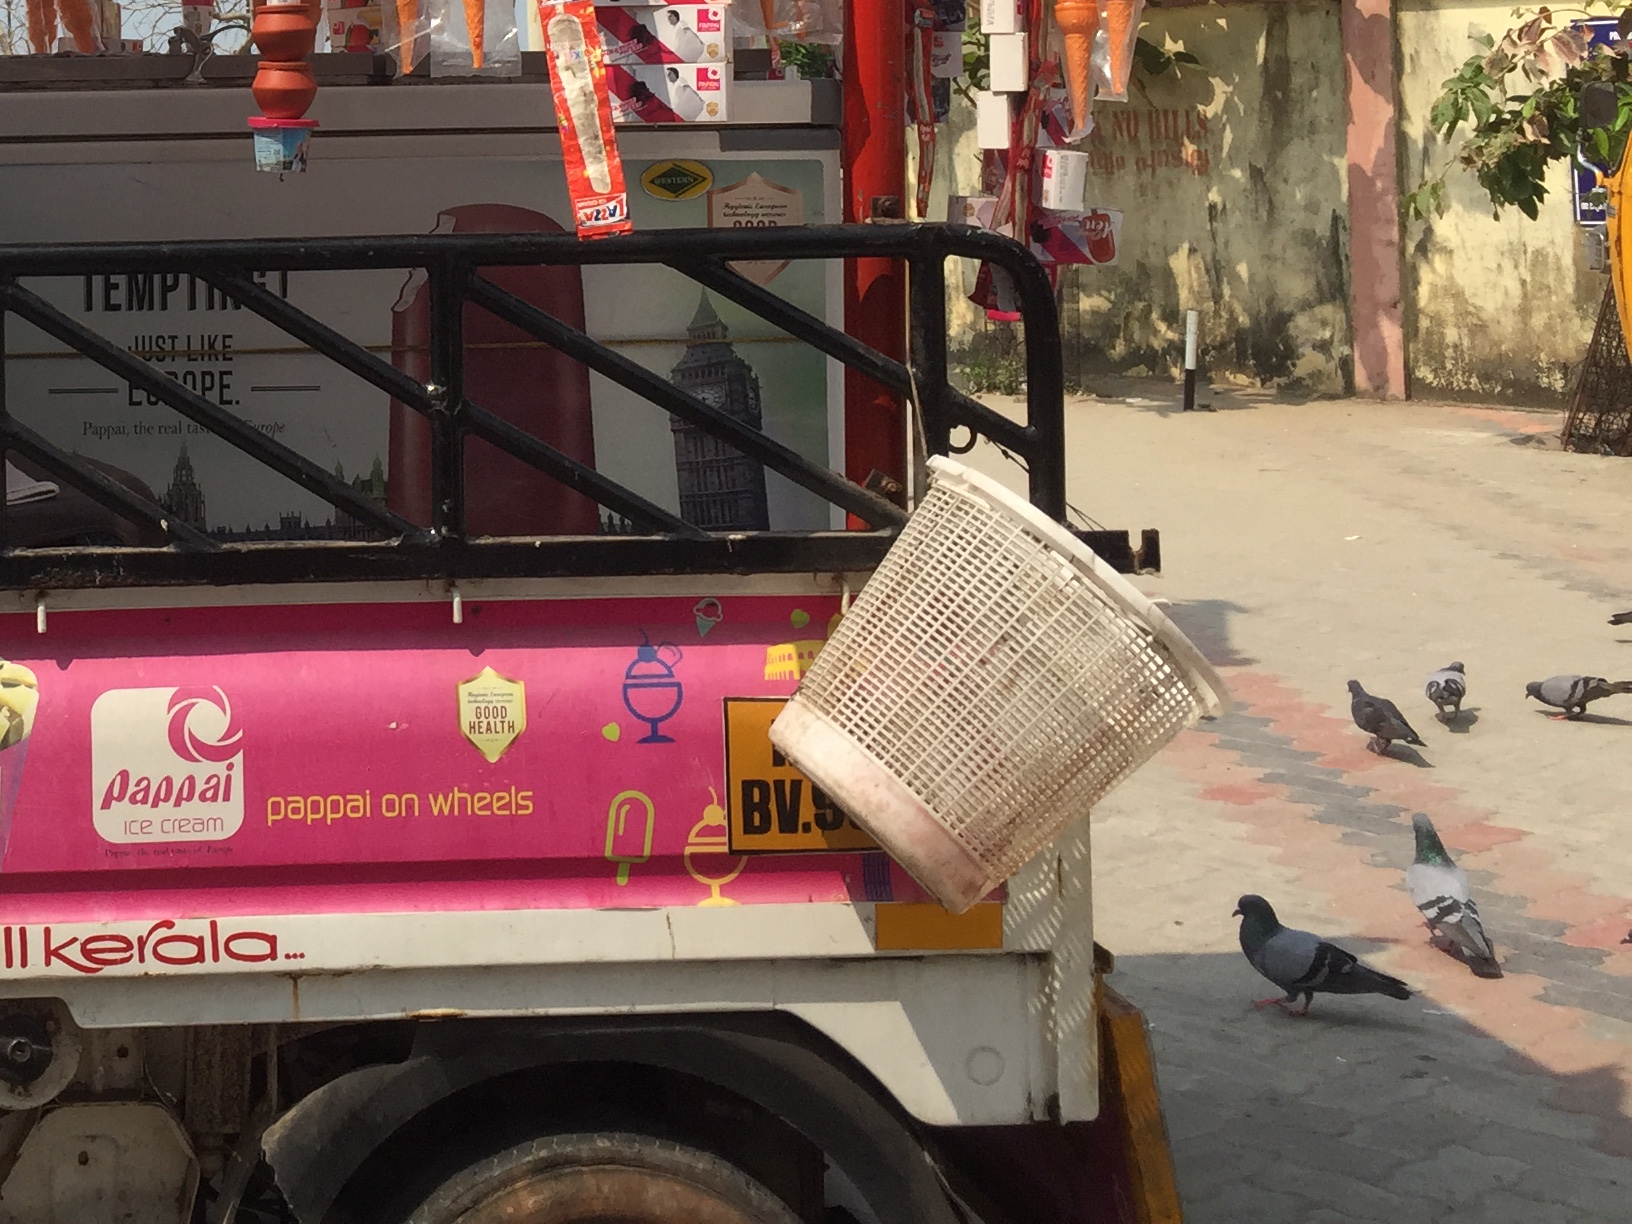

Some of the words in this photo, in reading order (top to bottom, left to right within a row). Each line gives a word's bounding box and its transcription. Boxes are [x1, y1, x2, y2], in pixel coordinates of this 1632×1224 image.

[654, 176, 695, 185] WESTERN
[128, 334, 178, 363] JUST
[187, 334, 234, 362] LIKE
[133, 421, 154, 435] the
[157, 420, 182, 435] real
[474, 705, 508, 720] GOOD
[469, 720, 516, 735] HEALTH
[267, 789, 371, 827] pappai
[381, 792, 419, 818] on
[429, 786, 533, 817] wheels
[123, 819, 153, 836] ice
[161, 816, 224, 834] cream
